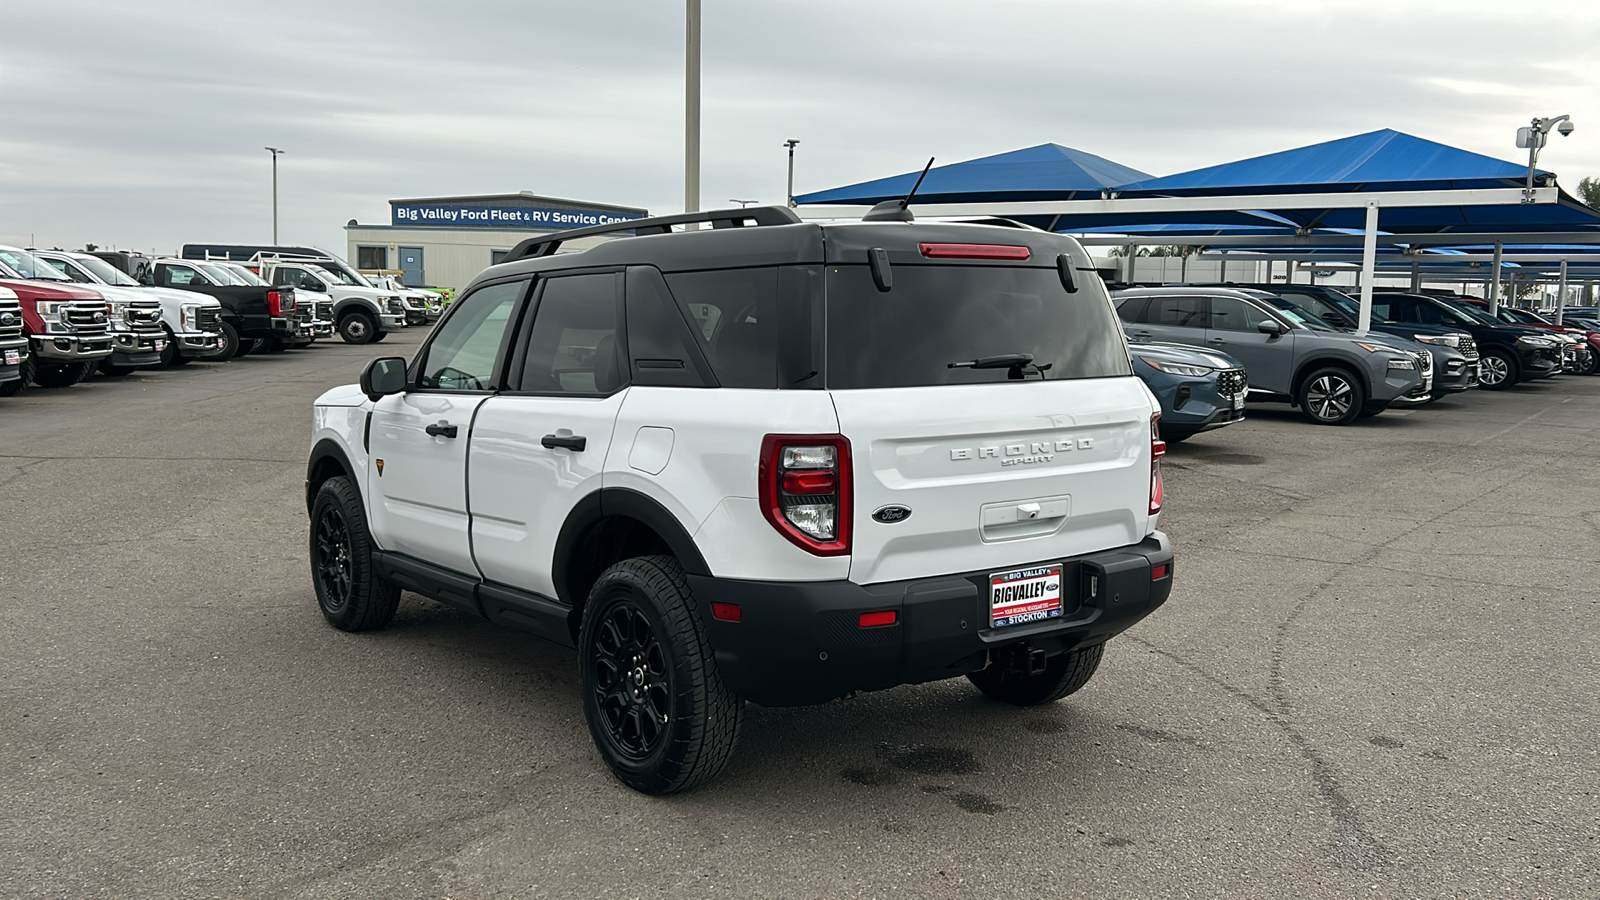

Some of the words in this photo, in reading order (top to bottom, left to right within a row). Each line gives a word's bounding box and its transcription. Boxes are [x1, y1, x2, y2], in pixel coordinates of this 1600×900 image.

[397, 208, 418, 220] Big
[420, 208, 458, 221] Valley
[460, 209, 488, 220] Ford
[490, 210, 521, 221] Fleet
[523, 213, 530, 221] &
[532, 211, 550, 221] RV
[552, 212, 597, 224] Service
[950, 438, 1094, 461] BRONCO
[1001, 454, 1054, 466] SPORT
[1009, 572, 1022, 580] BIG
[1022, 568, 1046, 577] VALLEY
[994, 581, 1047, 604] BIGVALLEY
[1009, 611, 1048, 624] STOCKTON
